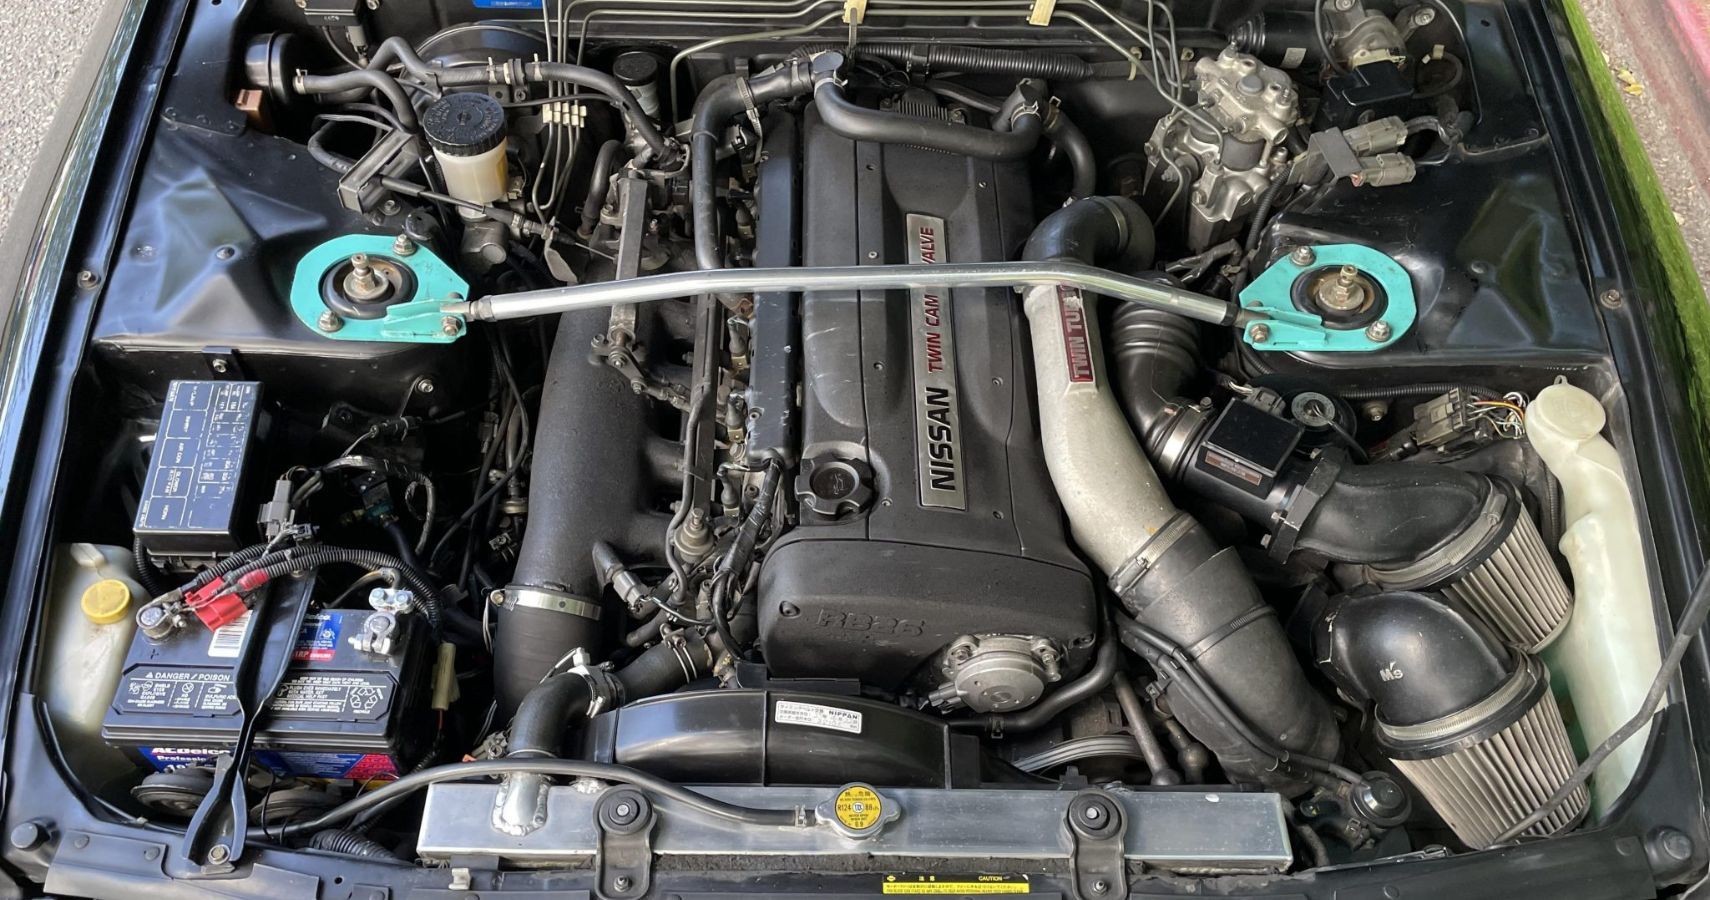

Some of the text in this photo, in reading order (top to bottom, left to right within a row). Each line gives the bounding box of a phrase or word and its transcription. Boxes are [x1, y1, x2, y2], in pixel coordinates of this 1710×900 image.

[924, 294, 940, 327] CAM
[926, 332, 944, 373] TWIN
[1069, 336, 1090, 378] TWIN
[925, 386, 957, 491] NISSAN
[155, 672, 190, 680] DANGER
[199, 673, 231, 681] POISON
